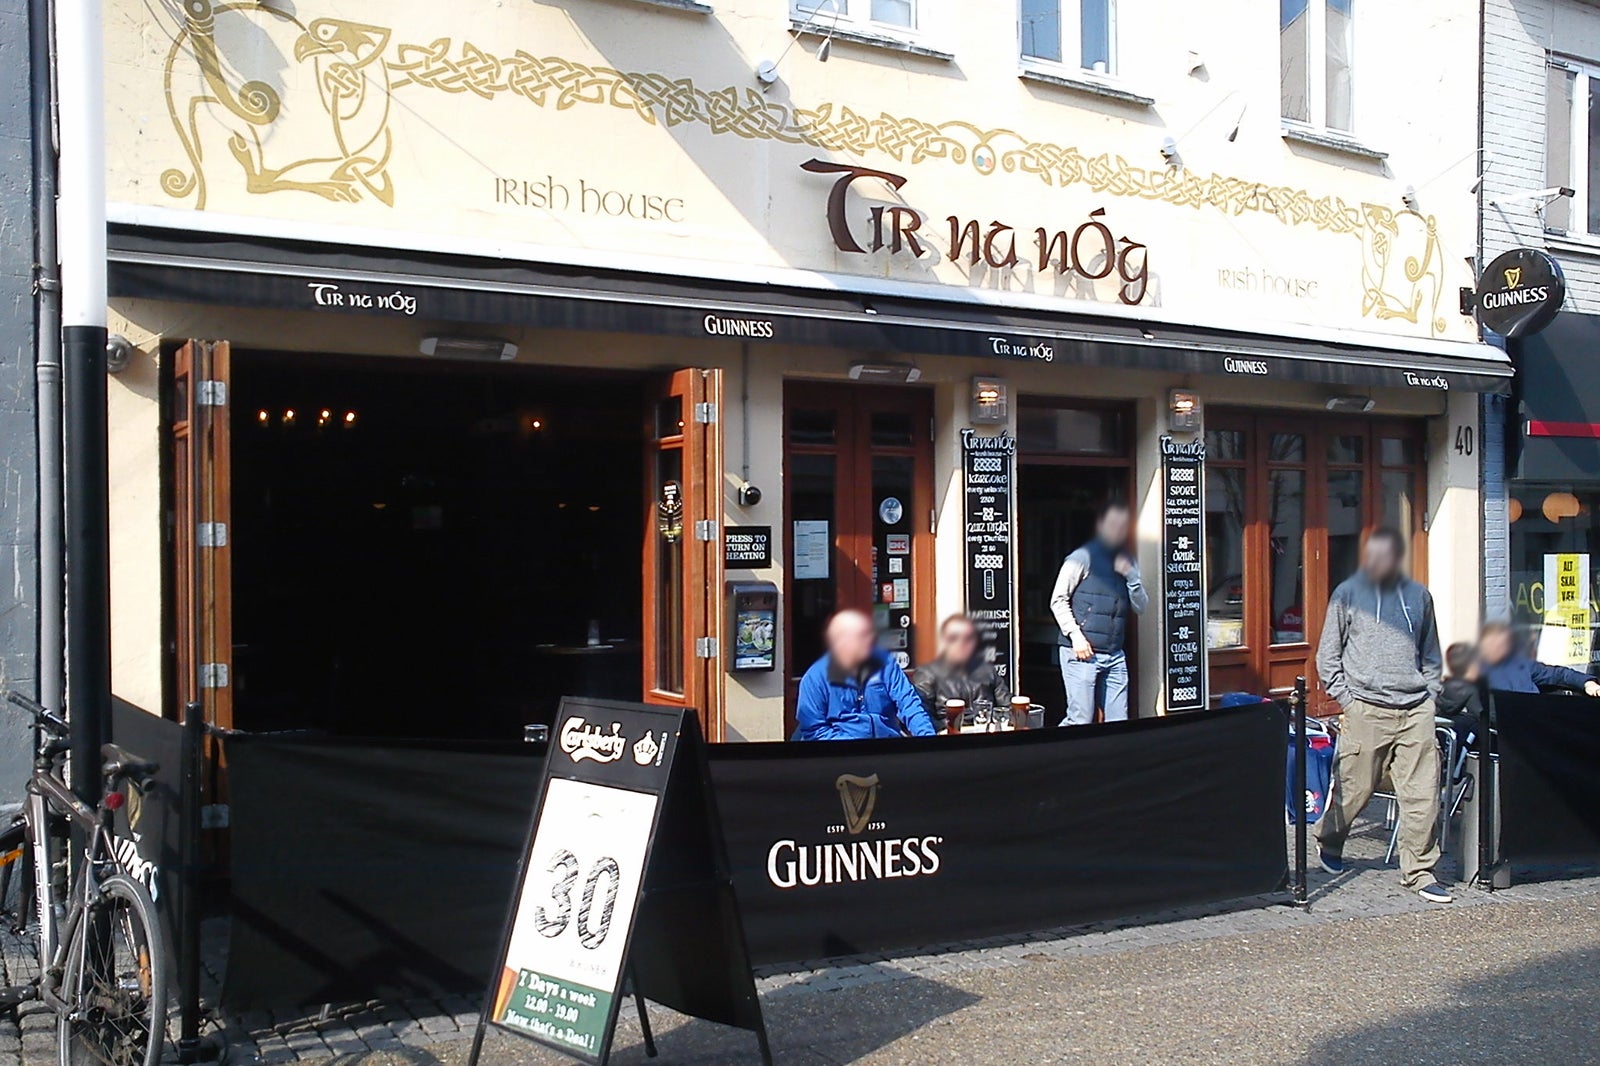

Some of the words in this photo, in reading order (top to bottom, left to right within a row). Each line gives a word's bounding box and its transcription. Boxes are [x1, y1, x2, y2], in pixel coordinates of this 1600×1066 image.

[946, 215, 1020, 268] na
[348, 294, 373, 308] na
[1483, 286, 1548, 309] GUINNESS
[704, 314, 774, 338] GUINNESS
[1224, 357, 1268, 375] GUINNESS
[1455, 426, 1473, 456] 40
[1169, 485, 1197, 496] SPORT
[725, 534, 754, 543] PRESS
[754, 534, 767, 543] TO
[725, 543, 751, 551] TURN
[751, 542, 766, 551] ON
[725, 551, 766, 560] HEATING
[1563, 560, 1574, 572] ALT
[1560, 575, 1576, 587] SKAL
[1561, 591, 1575, 602] VÆK
[560, 716, 627, 763] Carlsberg
[868, 822, 886, 830] 1759
[767, 836, 941, 888] GUINNESS
[534, 848, 620, 950] 30
[518, 970, 528, 987] 7
[528, 973, 560, 998] Days
[560, 988, 567, 1000] a
[568, 989, 597, 1008] week
[524, 994, 549, 1014] 12.00
[554, 1003, 579, 1023] 19.00
[504, 1008, 530, 1026] Now
[529, 1015, 556, 1036] that's
[556, 1027, 563, 1039] a
